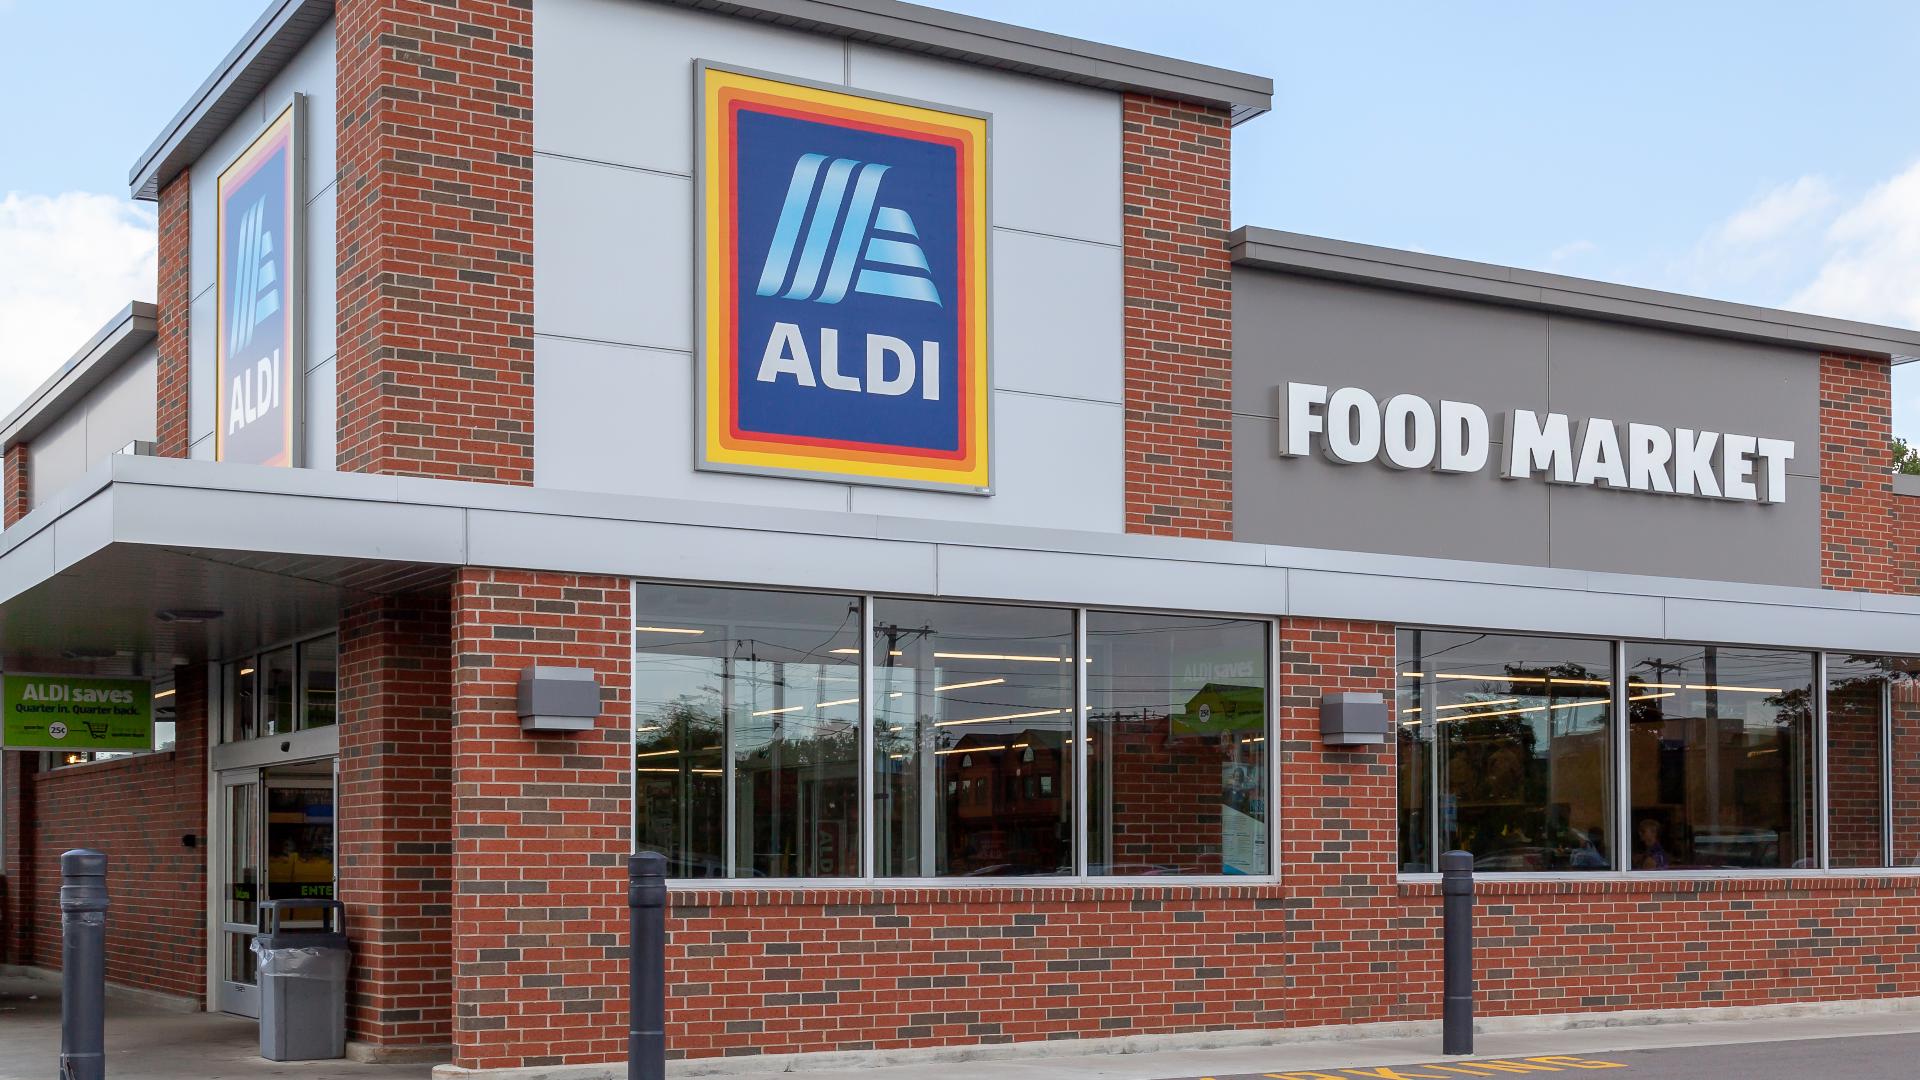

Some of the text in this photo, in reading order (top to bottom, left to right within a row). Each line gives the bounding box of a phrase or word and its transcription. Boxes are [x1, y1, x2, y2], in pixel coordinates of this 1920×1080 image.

[228, 348, 280, 436] ALDI
[756, 321, 940, 401] ALDI
[1280, 381, 1795, 504] FOOD MARKET
[15, 703, 140, 716] Quarter in. Quarter back.
[22, 683, 134, 704] ALDI saves
